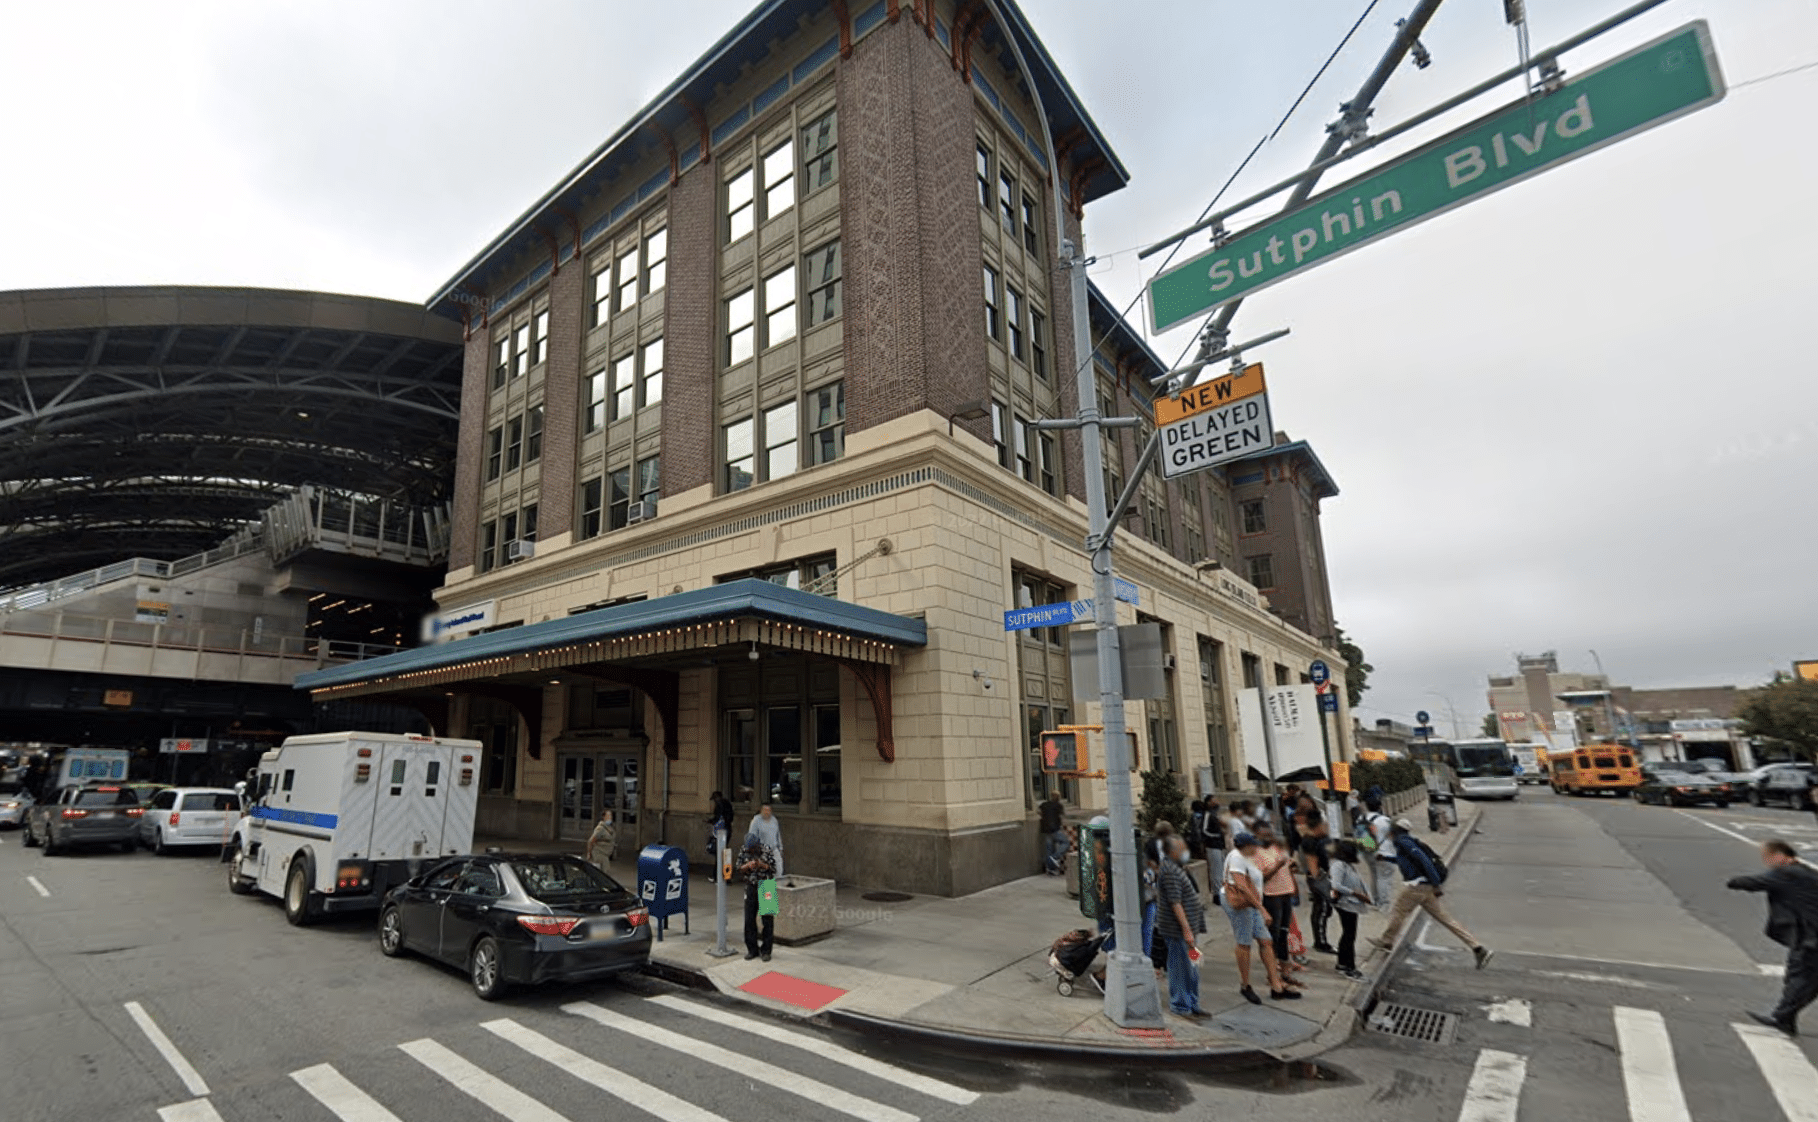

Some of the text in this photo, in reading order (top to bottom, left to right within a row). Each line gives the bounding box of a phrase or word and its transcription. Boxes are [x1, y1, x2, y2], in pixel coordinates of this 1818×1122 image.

[1208, 94, 1594, 292] Sutphin Blvd
[1181, 380, 1231, 413] NEW
[1167, 401, 1259, 446] DELAYED
[1172, 425, 1262, 466] GREEN
[1008, 610, 1052, 626] SUTPHIN
